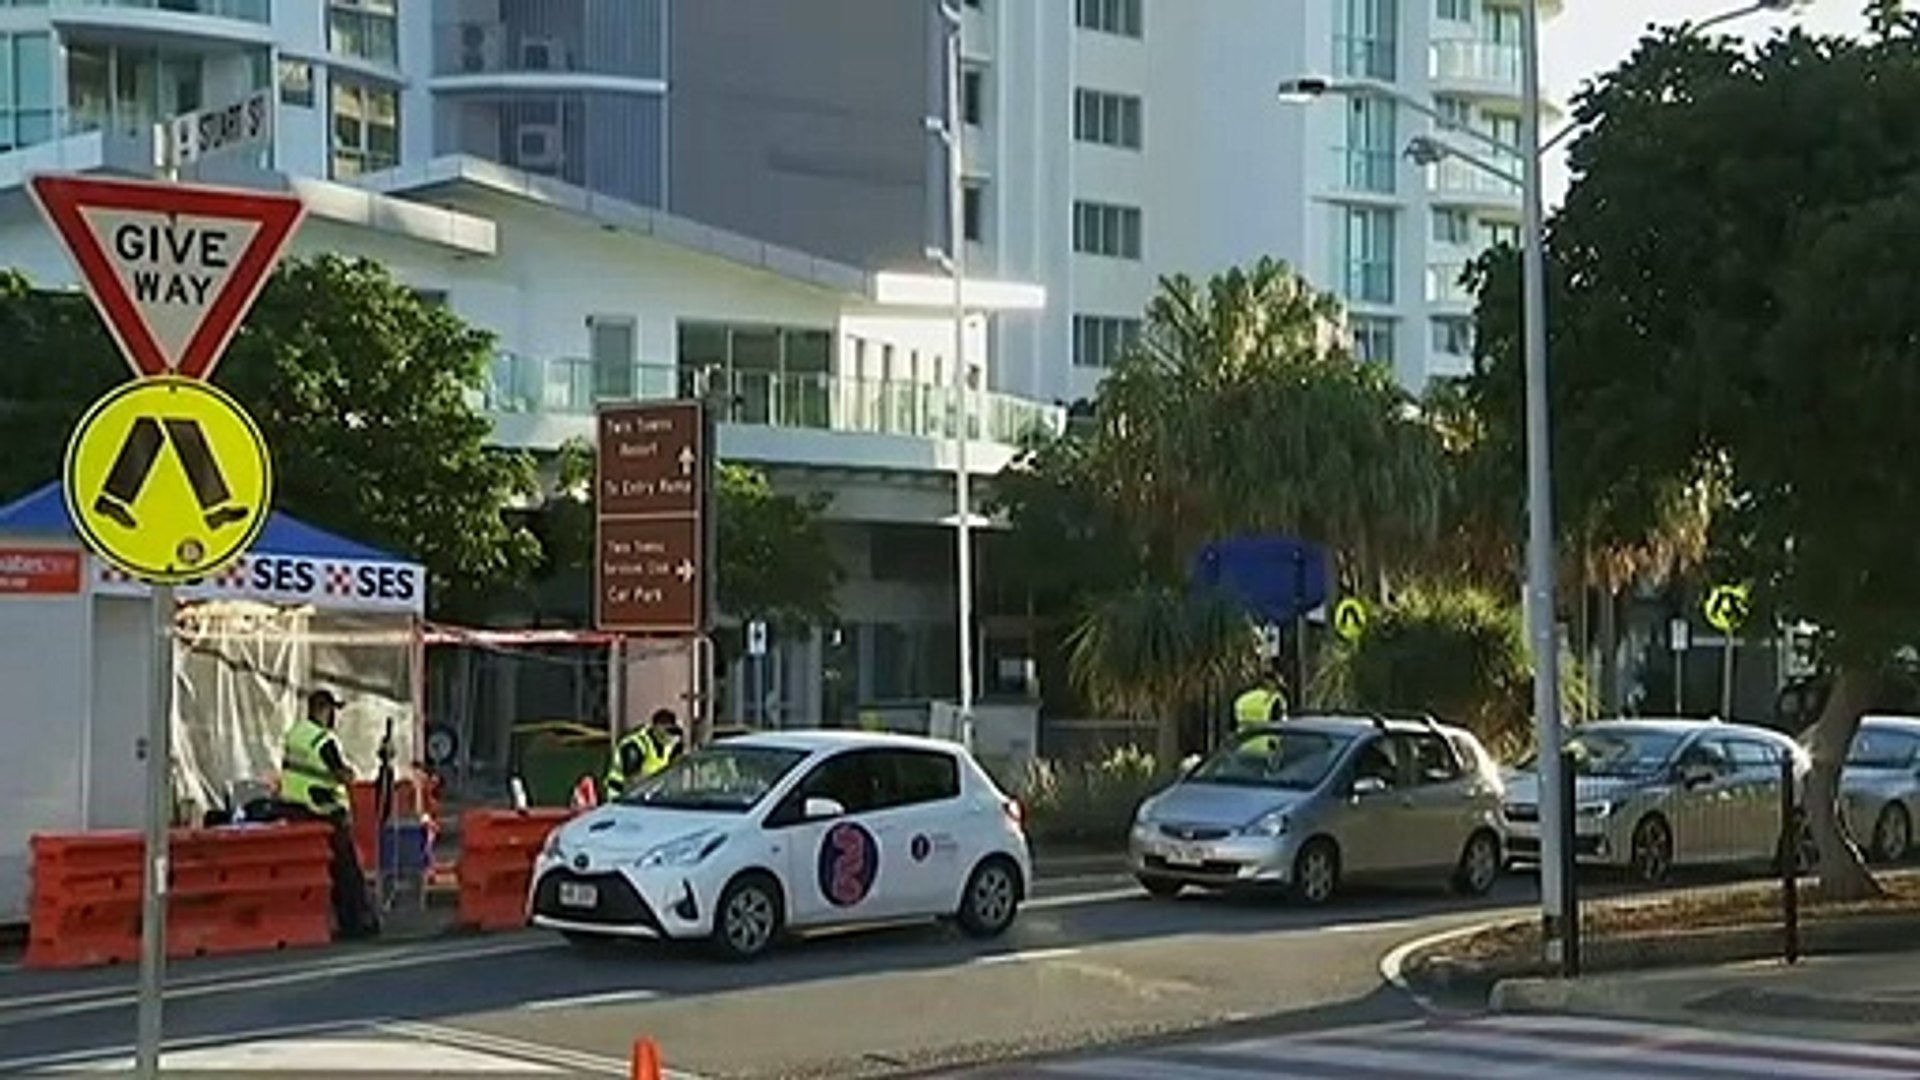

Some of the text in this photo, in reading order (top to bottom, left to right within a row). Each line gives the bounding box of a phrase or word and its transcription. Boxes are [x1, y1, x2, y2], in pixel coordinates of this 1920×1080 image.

[116, 224, 228, 268] GIVE
[134, 270, 212, 305] WAY
[622, 480, 654, 498] Entry
[253, 557, 415, 600] SES SES
[607, 585, 662, 603] Car Park
